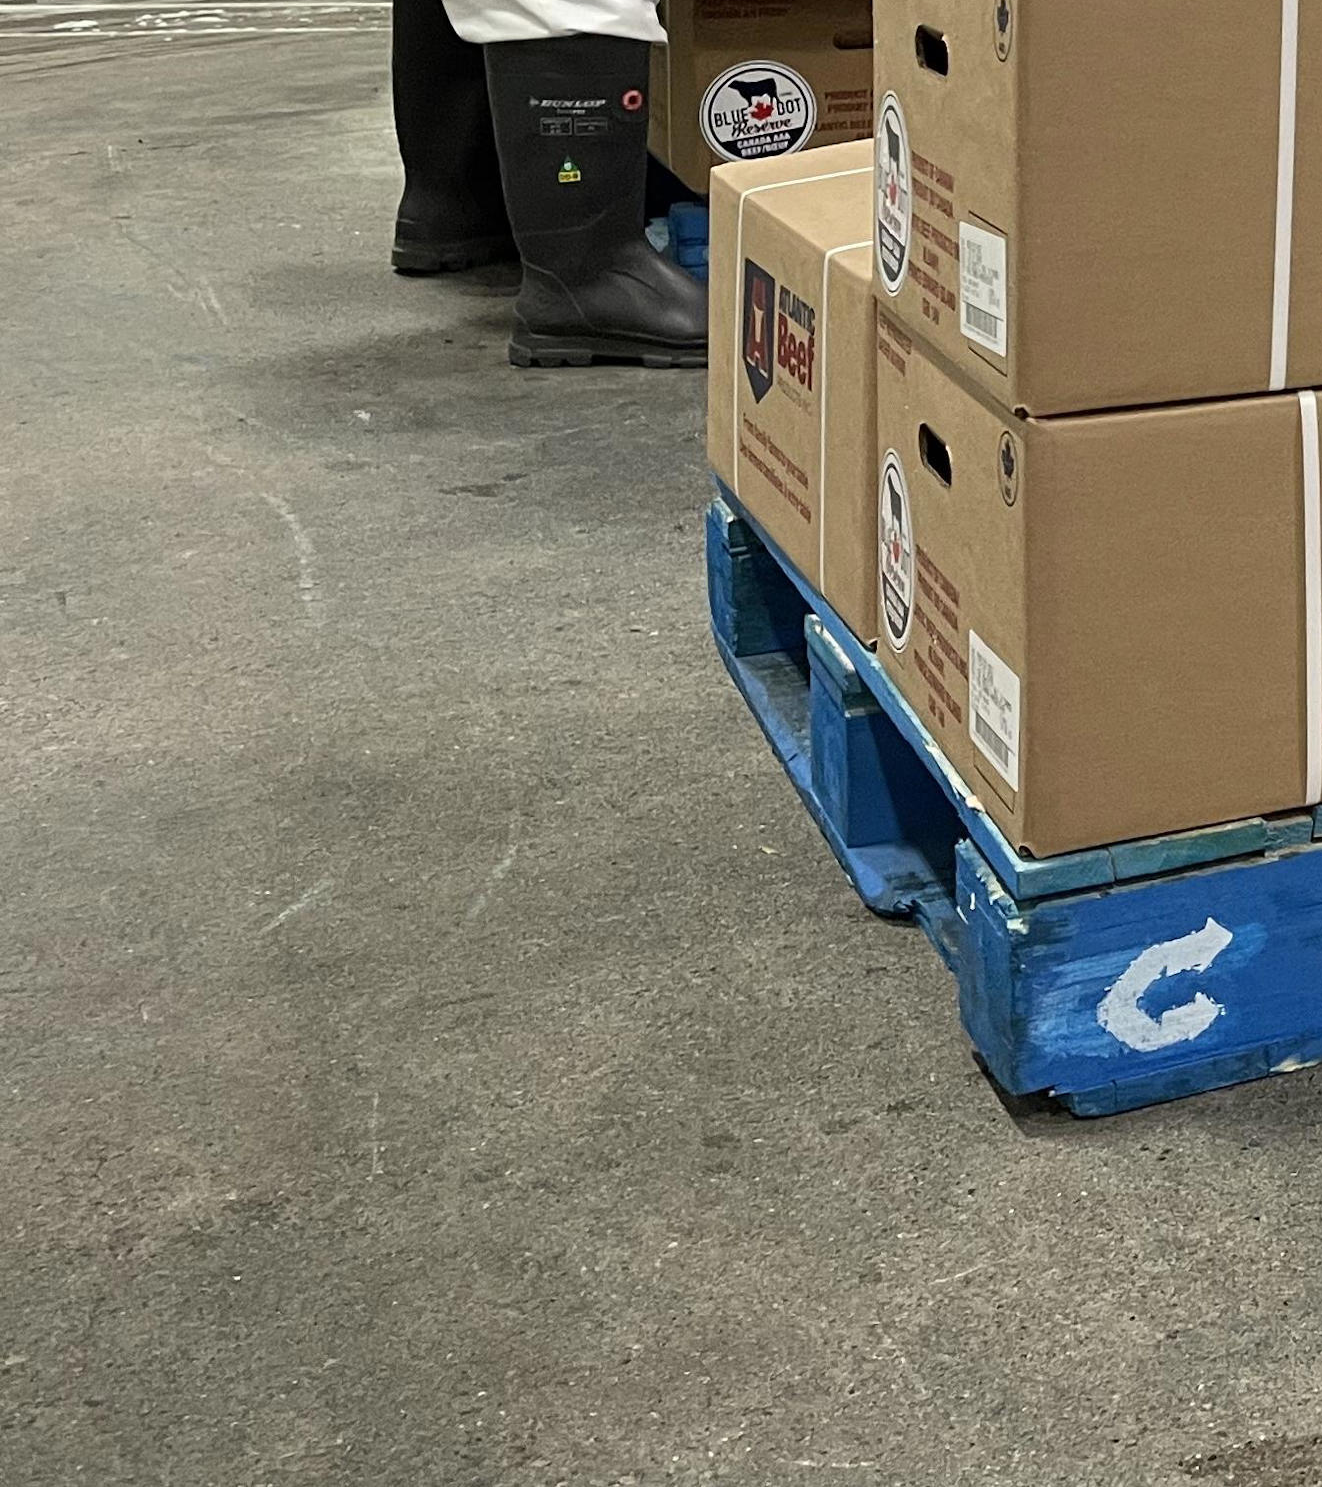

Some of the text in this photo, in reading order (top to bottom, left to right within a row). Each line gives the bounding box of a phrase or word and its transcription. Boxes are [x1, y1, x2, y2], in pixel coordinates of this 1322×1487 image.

[541, 99, 606, 108] DUNLOP
[714, 97, 802, 128] BLUE DOT
[773, 131, 791, 142] AAA
[779, 284, 816, 337] ATLANTIC
[777, 312, 815, 392] Beef
